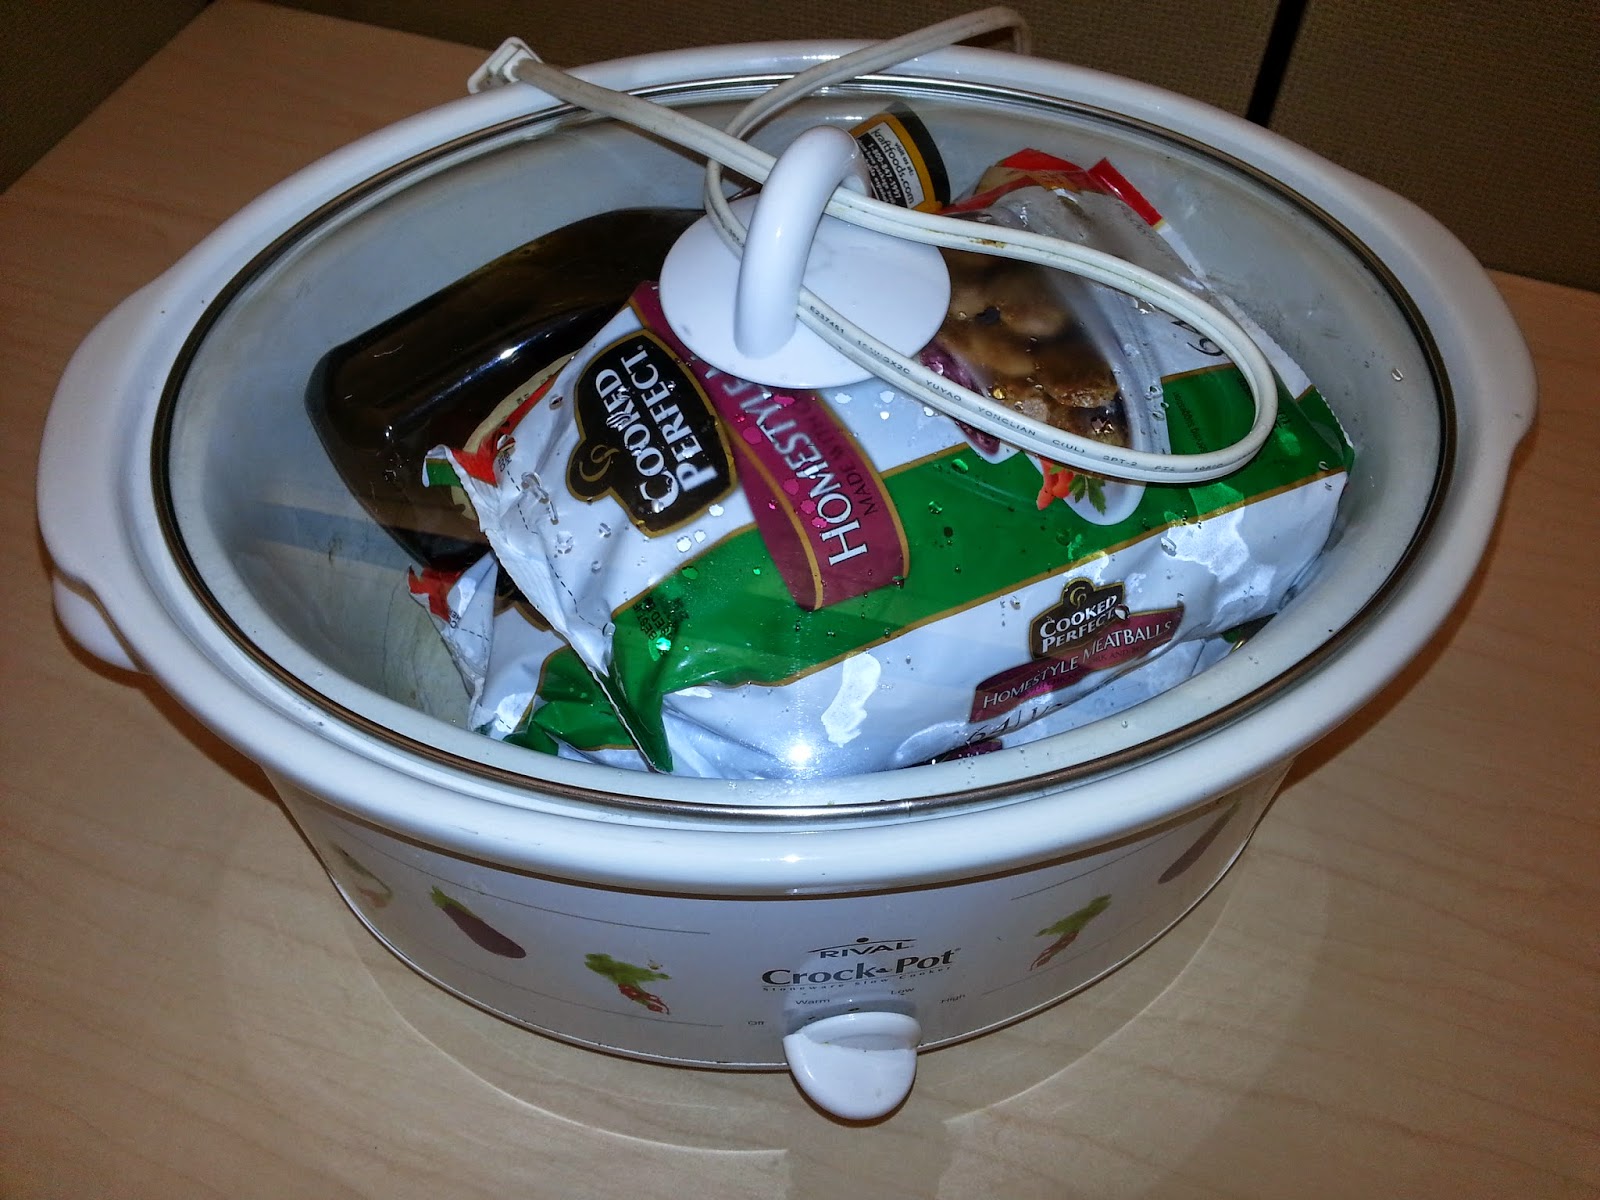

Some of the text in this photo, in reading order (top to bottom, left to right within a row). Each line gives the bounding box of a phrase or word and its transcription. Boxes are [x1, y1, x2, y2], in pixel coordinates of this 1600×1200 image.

[871, 128, 915, 205] kraftfoods.com
[926, 379, 962, 402] YUYAO
[594, 366, 681, 513] COOKED
[842, 461, 878, 517] MADE
[1039, 595, 1118, 638] COOKED
[982, 655, 1079, 709] HOMESTYLE
[1081, 620, 1172, 664] MEATBALLS
[820, 942, 909, 959] RIVAL
[891, 987, 915, 996] Low
